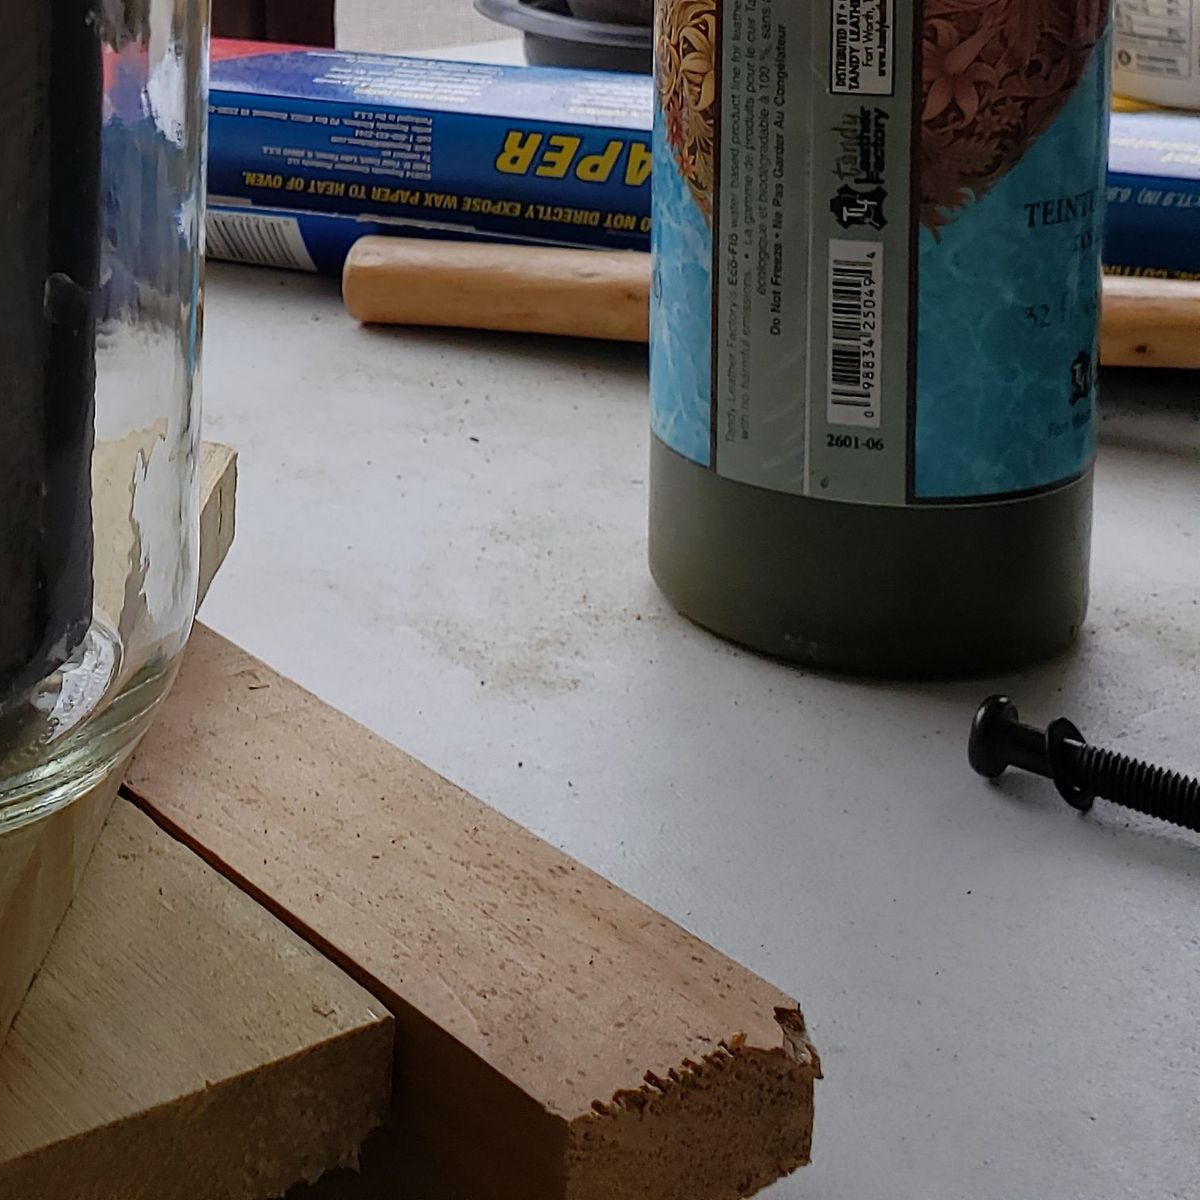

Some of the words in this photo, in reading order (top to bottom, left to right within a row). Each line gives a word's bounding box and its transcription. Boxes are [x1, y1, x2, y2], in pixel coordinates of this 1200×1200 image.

[762, 7, 772, 39] sans
[837, 13, 847, 25] BY
[731, 46, 741, 62] for
[744, 46, 755, 58] le
[836, 29, 847, 86] DISTRIBUTED
[862, 47, 874, 67] Fort
[730, 67, 741, 90] line
[745, 62, 756, 93] pour
[759, 66, 769, 89] 100
[849, 46, 860, 90] TANDY
[730, 94, 743, 145] product
[744, 97, 756, 150] produits
[773, 111, 784, 129] Au
[773, 134, 784, 178] Garder
[870, 107, 890, 184] Factory
[242, 170, 282, 188] OVEN.
[286, 176, 304, 191] OF
[307, 180, 345, 197] HEAT
[349, 185, 367, 199] TO
[372, 186, 420, 205] PAPER
[423, 192, 458, 210] WAX
[772, 183, 784, 207] Pas
[462, 196, 521, 217] EXPOSE
[525, 204, 600, 226] DIRECTLY
[603, 213, 636, 231] NOT
[772, 212, 783, 229] Ne
[771, 243, 782, 286] Freeze
[770, 290, 781, 313] Not
[863, 278, 876, 330] 25049
[770, 318, 781, 335] Do
[862, 339, 874, 390] 98834
[826, 433, 884, 451] 2601-06
